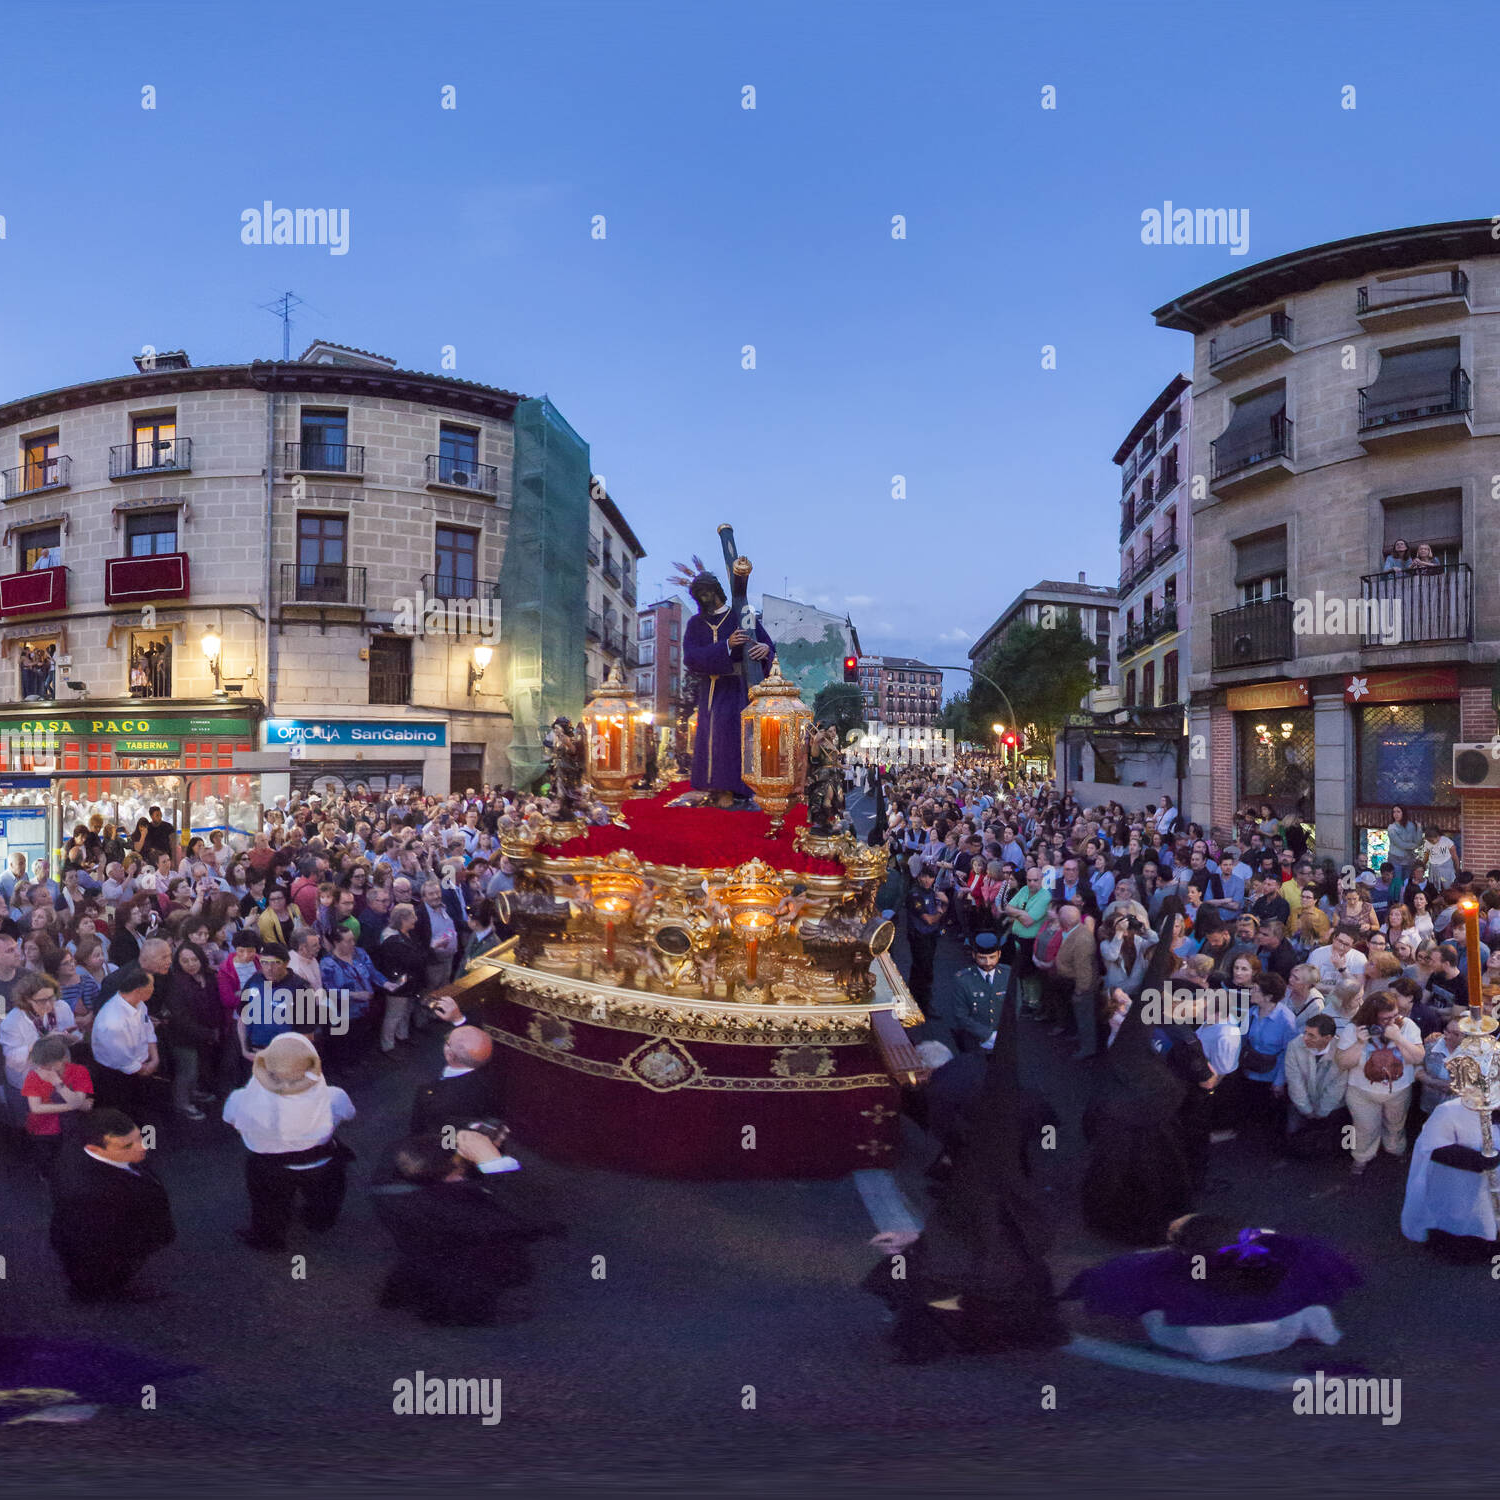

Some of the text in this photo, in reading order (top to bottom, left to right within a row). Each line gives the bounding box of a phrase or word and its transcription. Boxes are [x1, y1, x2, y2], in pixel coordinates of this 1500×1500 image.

[21, 721, 150, 733] CASA PACO
[351, 728, 437, 742] SanGabino
[126, 741, 169, 750] TABERNA
